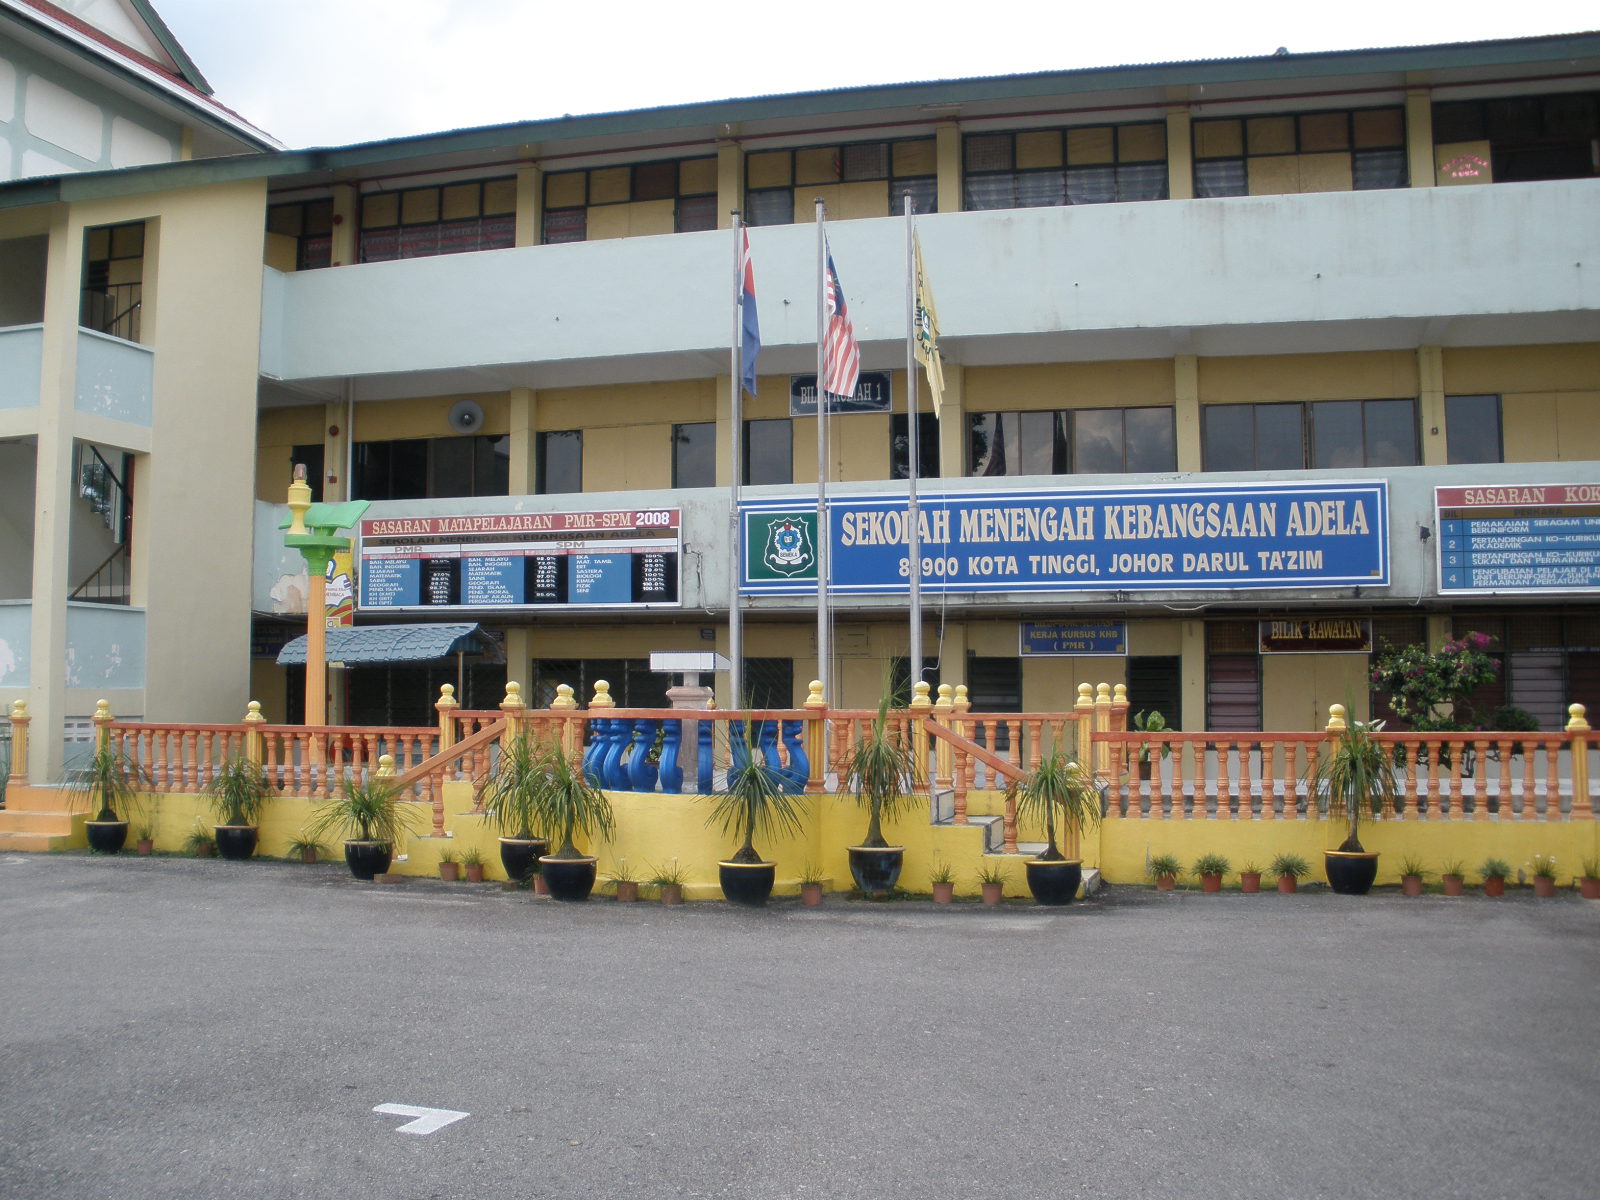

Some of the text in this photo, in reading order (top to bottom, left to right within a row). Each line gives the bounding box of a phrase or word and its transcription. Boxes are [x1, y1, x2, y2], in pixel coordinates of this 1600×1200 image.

[1464, 488, 1546, 505] SASARAN
[372, 512, 670, 535] SASARAN MATAPELAJARAN PMR-SPM 2008
[959, 506, 1095, 544] MENENGAH
[1104, 502, 1276, 540] KEBANGSAAN
[1286, 500, 1370, 536] ADELA
[1448, 524, 1454, 532] 1
[379, 530, 656, 545] SEKOLAH MENENGAH KEBANGSAAN ADELA
[1472, 536, 1542, 544] PERTANDINGAN
[1448, 540, 1456, 549] 2
[898, 550, 1323, 577] 8900 KOTA TINGGI, JOHOR DARUL TA'ZIM
[1449, 556, 1456, 565] 3
[1448, 574, 1456, 583] 4
[1030, 630, 1058, 639] KERJA
[1061, 630, 1096, 638] KURSUS
[1271, 620, 1361, 639] BILIK RAWATAN
